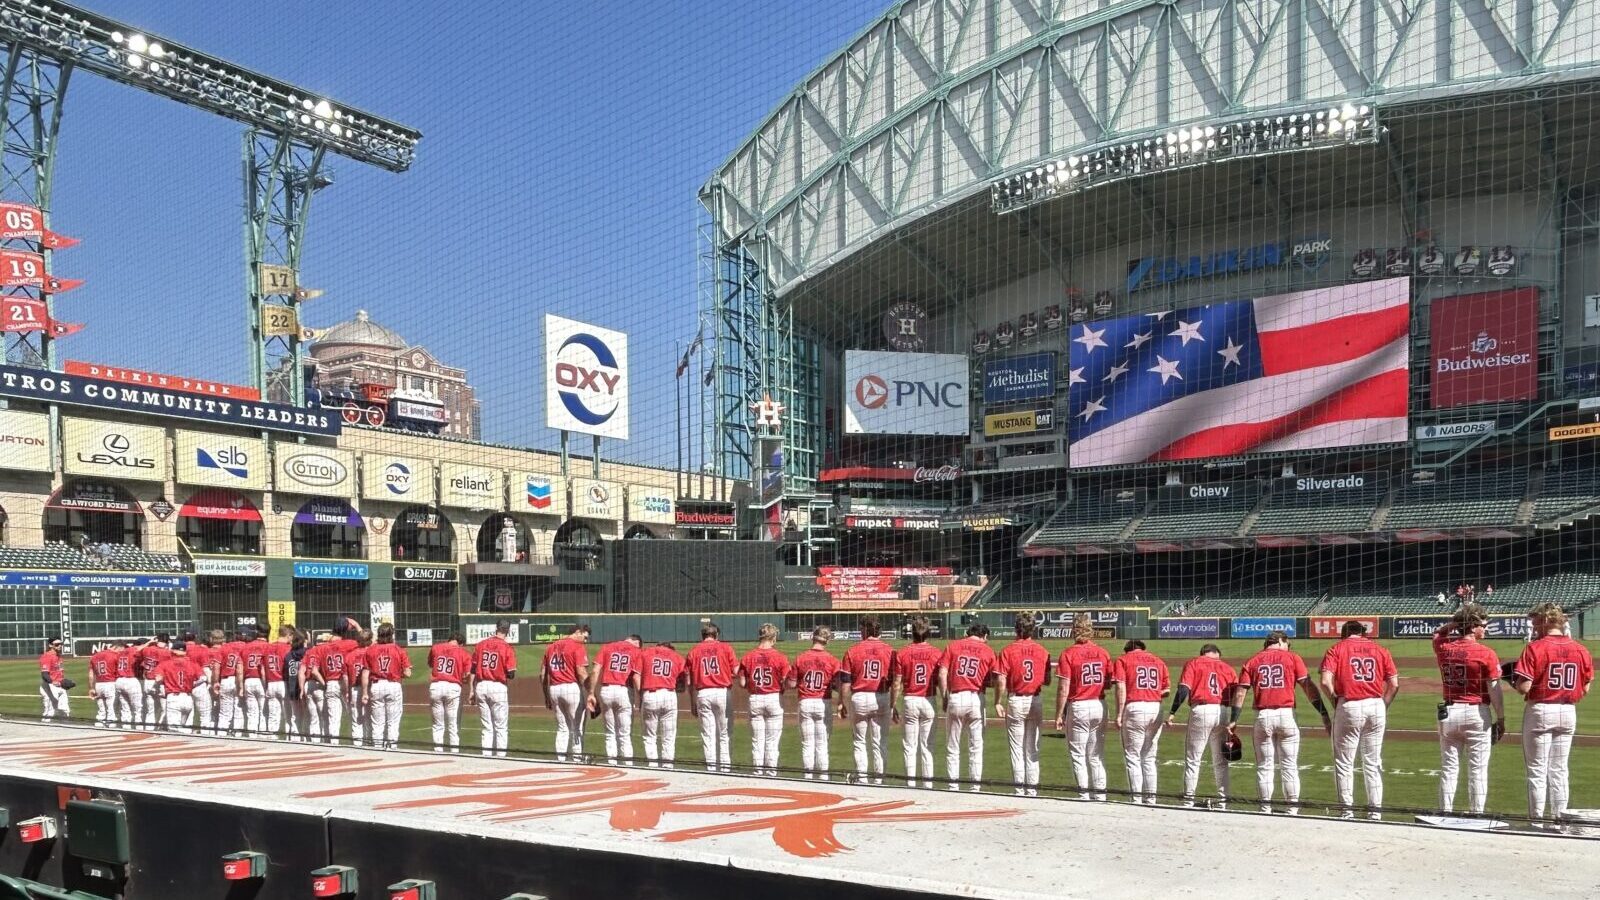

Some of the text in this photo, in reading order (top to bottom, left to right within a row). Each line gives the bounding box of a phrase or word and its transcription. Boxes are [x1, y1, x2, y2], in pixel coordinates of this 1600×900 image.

[6, 211, 34, 230] 05
[1293, 239, 1331, 256] PARK
[10, 260, 36, 277] 19
[270, 273, 288, 287] 17
[10, 305, 36, 321] 21
[271, 315, 289, 327] 22
[899, 319, 916, 335] H
[1437, 353, 1530, 372] Budweiser
[90, 366, 232, 395] DAIKIN PARK
[555, 362, 621, 395] OXY
[989, 368, 1049, 388] Methodist
[3, 372, 328, 428] TROS COMMUNITY LEADERS
[893, 381, 962, 408] PNC
[993, 416, 1031, 429] MUSTANG
[1036, 414, 1051, 425] CAT
[1439, 424, 1485, 436] NABORS
[77, 452, 155, 469] LEXUS
[217, 446, 248, 467] slb
[386, 474, 410, 483] OXY
[450, 476, 490, 491] reliant
[1296, 475, 1364, 490] Silverado
[1190, 485, 1229, 498] Chevy
[61, 499, 104, 508] CRAWFORD
[196, 507, 228, 515] equinor
[311, 503, 342, 514] planet
[314, 514, 348, 524] fitness
[675, 511, 736, 524] Budweiser
[855, 518, 892, 529] impact
[903, 518, 940, 530] impact
[963, 518, 1005, 527] PLUCKERS
[414, 569, 447, 580] EMCJET
[61, 591, 71, 653] AMERICAN
[237, 617, 256, 625] 366
[1161, 623, 1216, 633] xfinity mobile
[1245, 624, 1294, 632] HONDA
[1043, 628, 1061, 638] SPACE
[379, 656, 391, 673] 17
[437, 657, 455, 674] 38
[610, 653, 630, 672] 22
[652, 658, 672, 677] 20
[702, 656, 719, 676] 14
[863, 660, 881, 680] 19
[957, 656, 979, 678] 35
[1022, 660, 1034, 682] 3
[1351, 657, 1376, 682] 33
[753, 666, 772, 688] 45
[804, 670, 823, 690] 40
[914, 664, 927, 686] 2
[1081, 661, 1104, 686] 25
[1136, 665, 1159, 690] 29
[1258, 664, 1285, 689] 32
[1548, 662, 1577, 690] 50
[1208, 672, 1220, 696] 4
